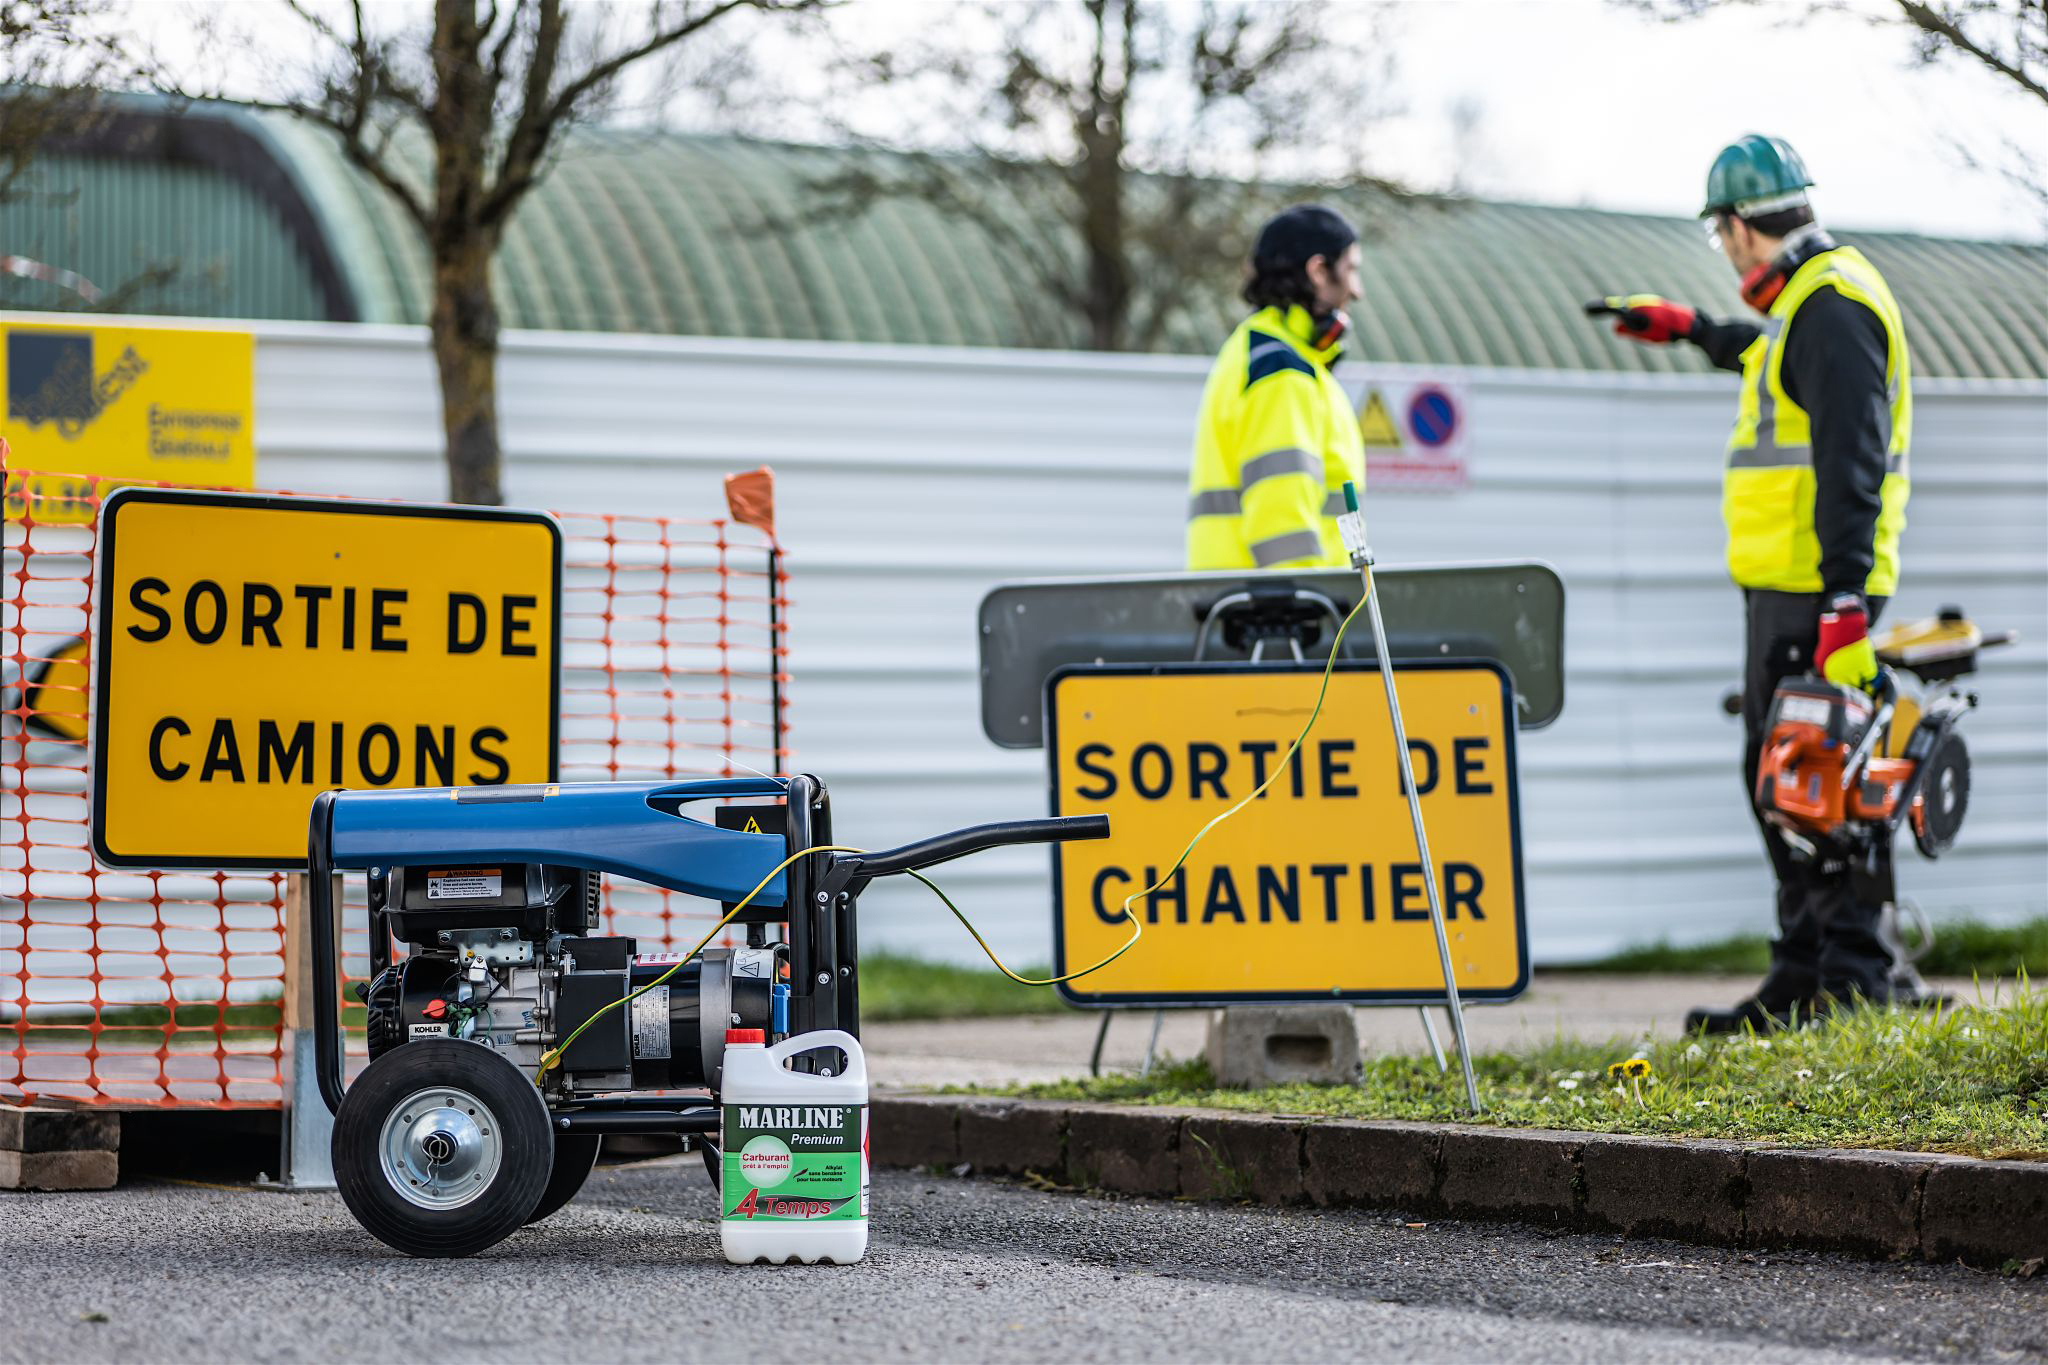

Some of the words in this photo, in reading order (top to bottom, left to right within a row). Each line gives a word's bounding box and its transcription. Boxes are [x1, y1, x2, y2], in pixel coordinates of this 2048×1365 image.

[127, 577, 408, 652] SORTIE
[448, 592, 538, 657] DE
[148, 716, 511, 786] CAMIONS
[1075, 741, 1359, 801] SORTIE
[1398, 737, 1494, 796] DE
[1091, 862, 1487, 925] CHANTIER
[414, 1026, 442, 1034] KOHLER
[739, 1107, 843, 1129] MARLINE
[790, 1133, 844, 1145] Premium
[742, 1153, 790, 1162] Carburant
[735, 1188, 759, 1219] 4
[764, 1197, 831, 1219] Temps
